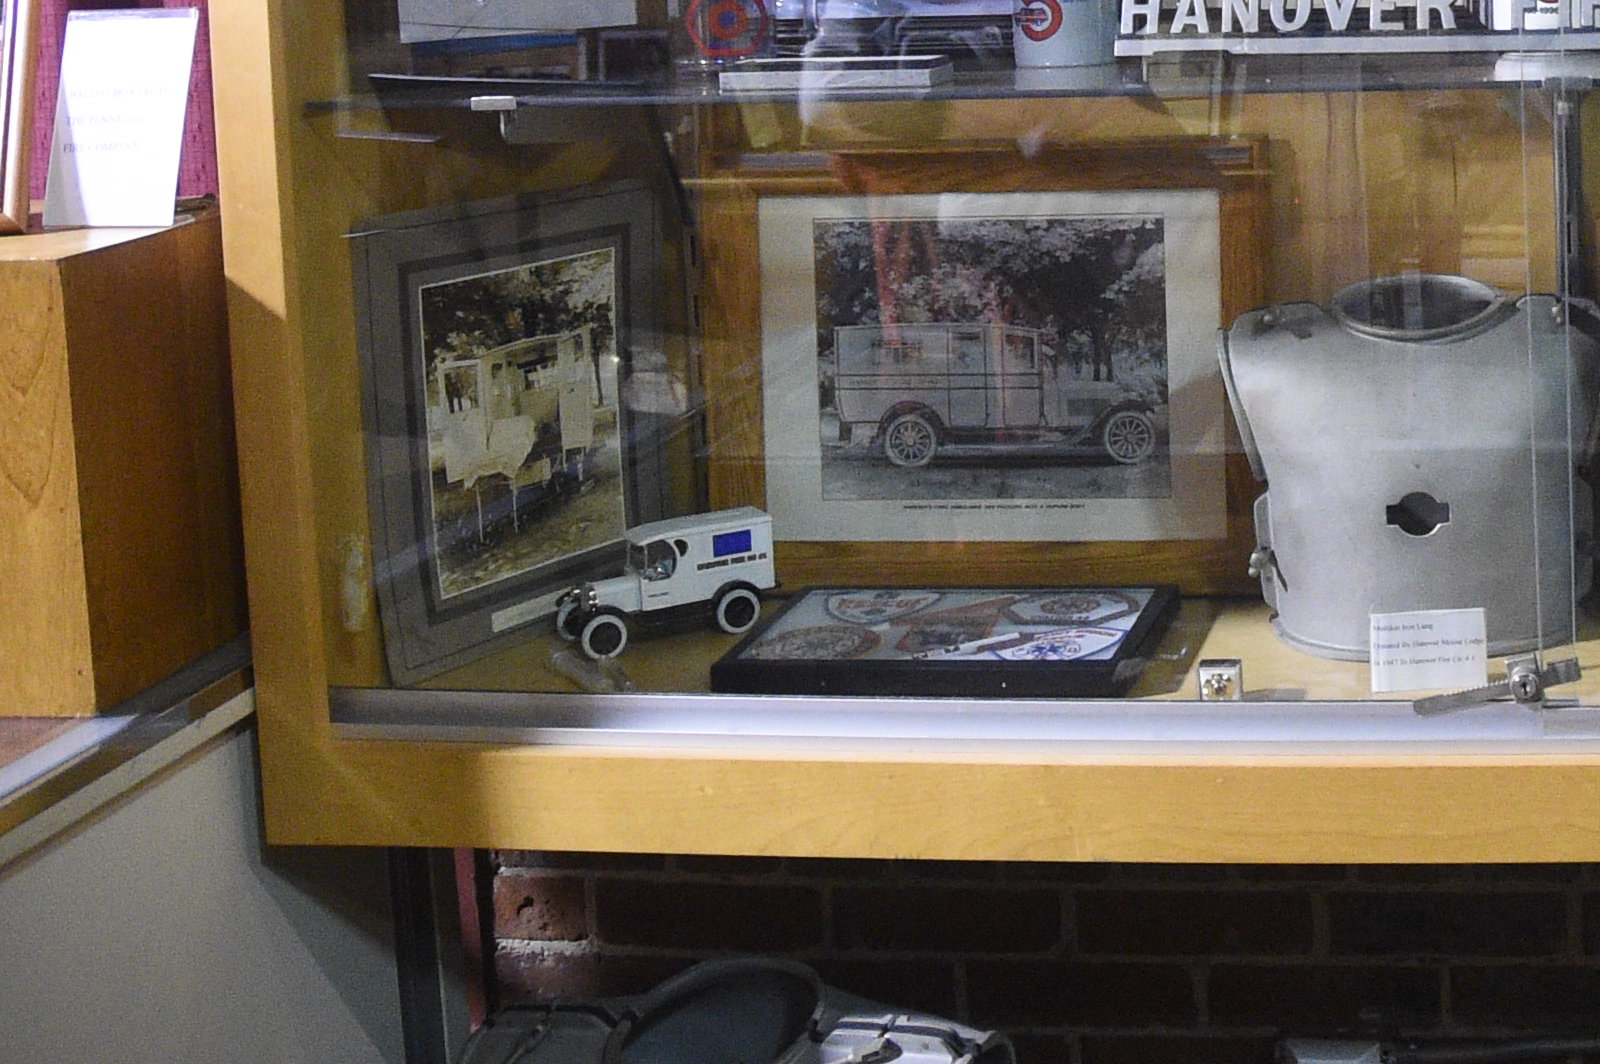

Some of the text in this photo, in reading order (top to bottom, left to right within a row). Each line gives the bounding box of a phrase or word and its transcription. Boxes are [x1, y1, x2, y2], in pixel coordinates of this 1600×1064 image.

[66, 115, 85, 127] THE
[63, 141, 140, 153] FIRE COMPANY
